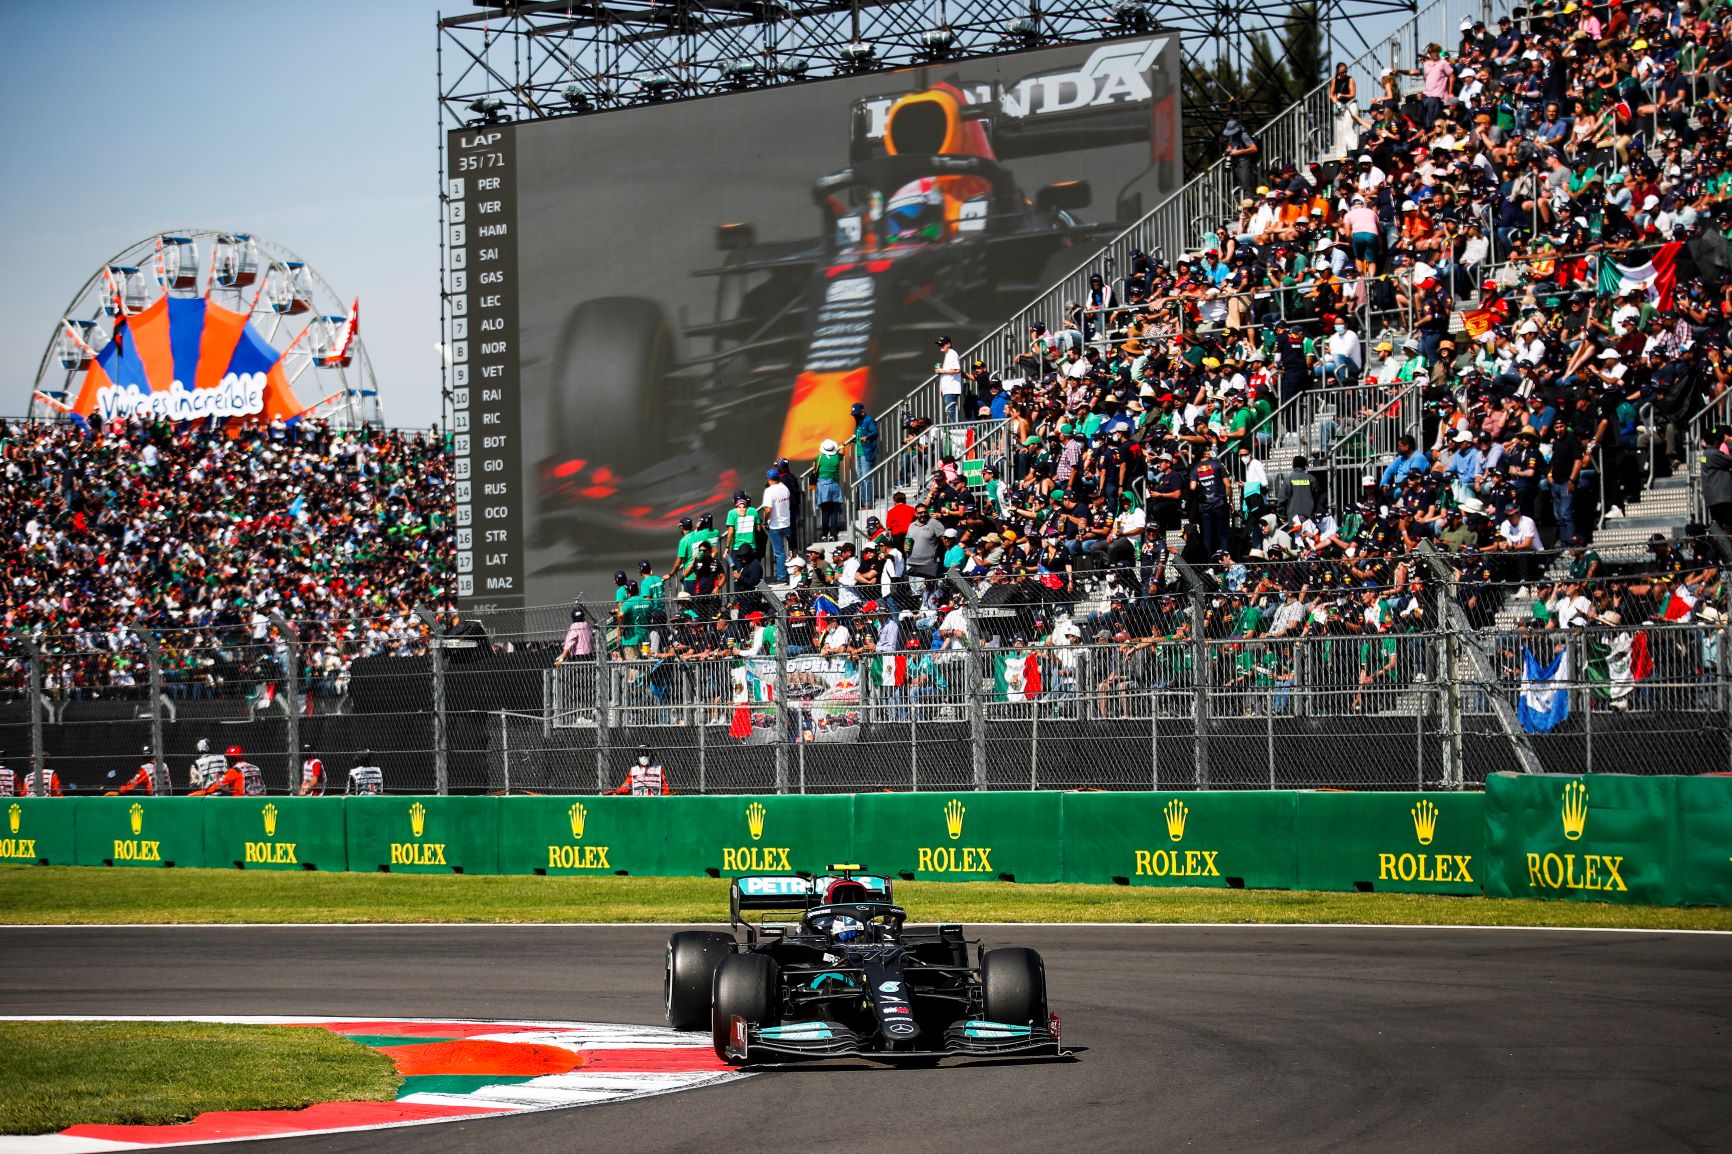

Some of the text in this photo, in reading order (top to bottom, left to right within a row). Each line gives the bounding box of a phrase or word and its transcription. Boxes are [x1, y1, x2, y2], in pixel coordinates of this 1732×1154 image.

[461, 133, 502, 149] LAP
[459, 152, 505, 171] 35/71
[454, 178, 500, 194] 1 PER
[454, 201, 501, 218] 2 VER
[455, 224, 507, 241] 3 HAM
[455, 248, 498, 264] 4 SAI
[456, 271, 503, 287] 5 GAS
[456, 295, 501, 310] 6 LEC
[457, 318, 504, 334] 7 ALO
[458, 342, 506, 357] 8 NOR
[458, 366, 504, 380] 9 VET
[456, 389, 501, 404] 10 RAI
[456, 413, 500, 427] 11 RIC
[457, 436, 506, 450] 12 BOT
[458, 460, 504, 474] 13 GIO
[458, 483, 506, 497] 14 RUS
[458, 507, 508, 521] 15 OCO
[459, 530, 507, 544] 16 STR
[460, 554, 508, 567] 17 LAT
[460, 577, 512, 591] 18 MAZ
[113, 840, 161, 861] ROLEX
[245, 842, 297, 864] ROLEX
[390, 844, 446, 865] ROLEX
[548, 846, 611, 868] ROLEX
[722, 848, 791, 870] ROLEX
[918, 847, 993, 872] ROLEX
[1136, 850, 1220, 876] ROLEX
[1379, 853, 1474, 882] ROLEX
[1527, 853, 1628, 891] ROLEX
